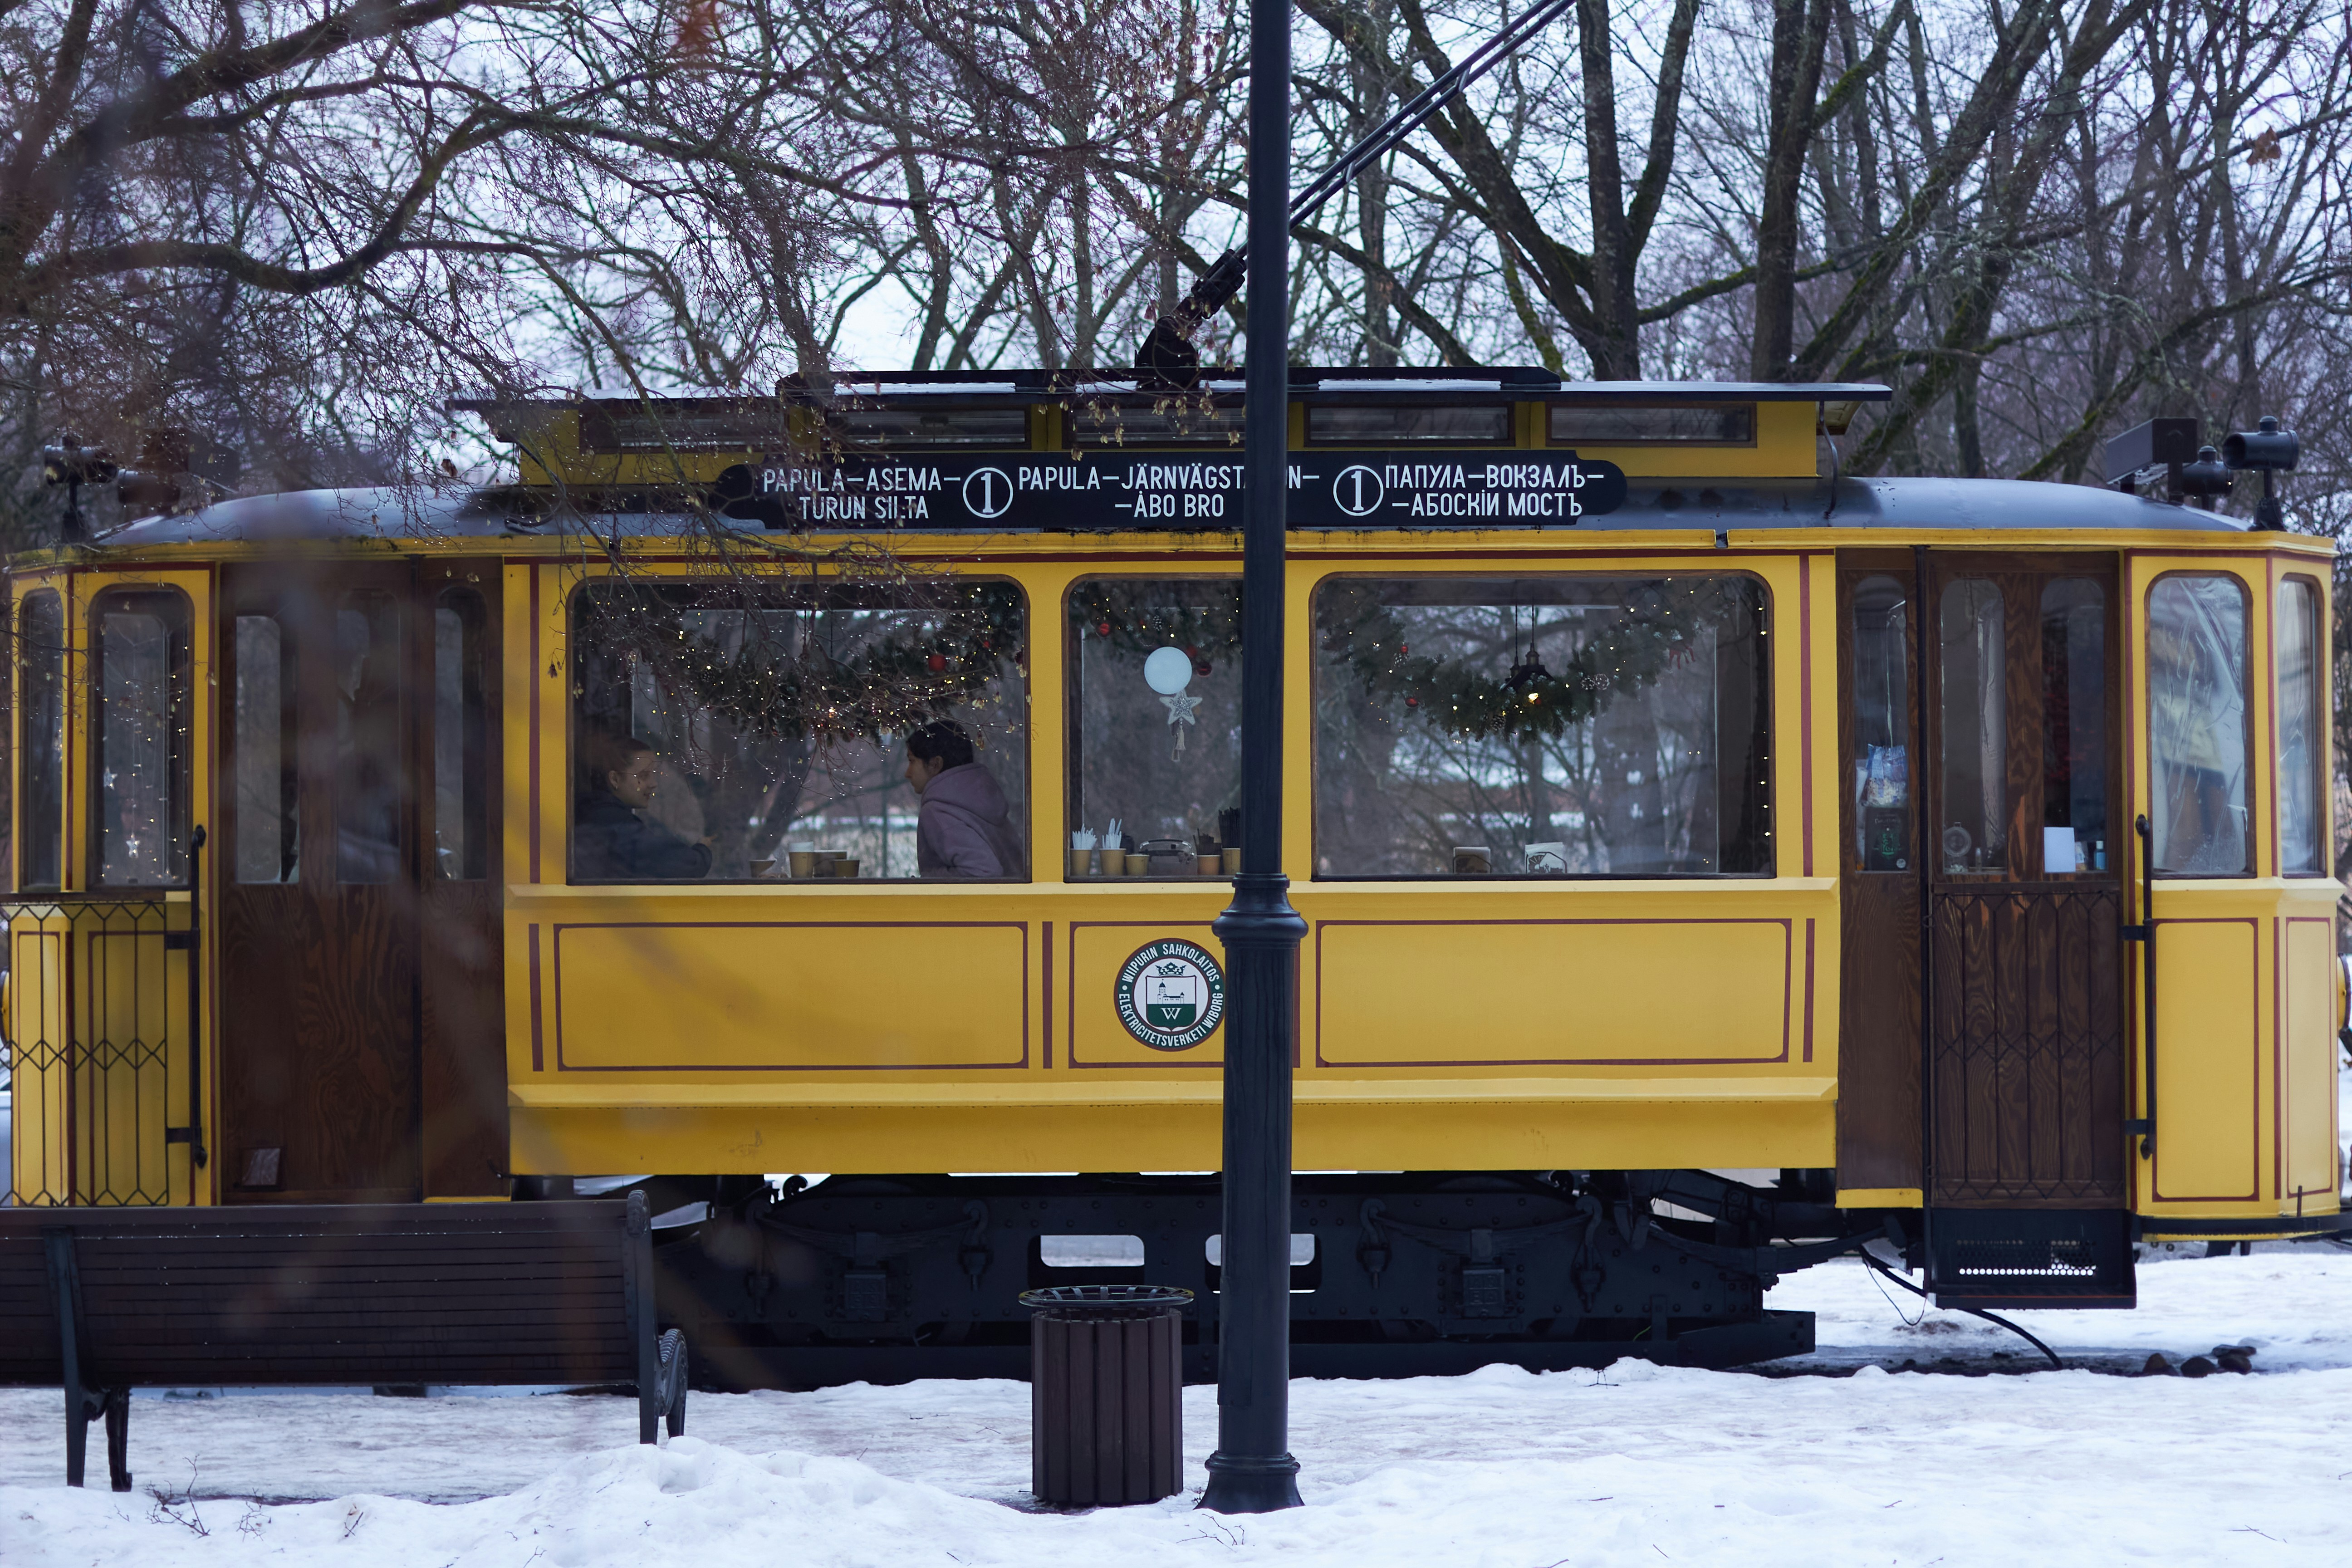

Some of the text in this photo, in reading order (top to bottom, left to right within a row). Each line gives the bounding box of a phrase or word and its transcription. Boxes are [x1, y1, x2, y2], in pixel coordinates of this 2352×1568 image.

[981, 472, 994, 513] 1
[1184, 494, 1224, 517] BRO
[1351, 470, 1364, 511] 1
[1508, 492, 1583, 516] МОСТЪ
[799, 495, 929, 520] TURUN SILTA
[1122, 946, 1158, 983] WIIPURIN
[1160, 1007, 1182, 1020] W
[1202, 992, 1224, 1029] WIBORG
